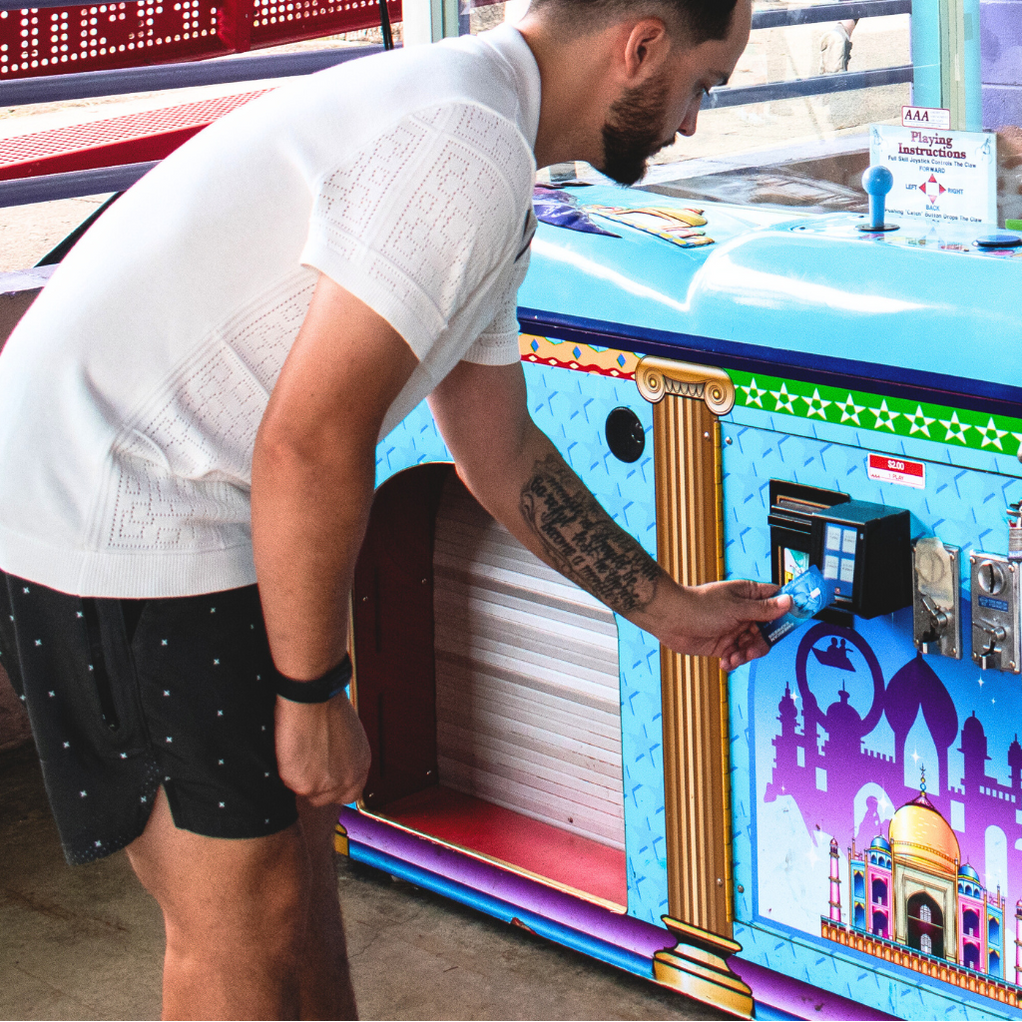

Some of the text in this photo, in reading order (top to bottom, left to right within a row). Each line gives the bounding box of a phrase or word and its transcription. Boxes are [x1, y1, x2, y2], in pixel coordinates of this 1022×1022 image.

[904, 109, 929, 122] AAA
[911, 131, 953, 149] Playing
[898, 143, 967, 159] Instructions
[910, 157, 930, 165] Joystick
[919, 166, 945, 174] FORWARD
[947, 187, 964, 195] RIGHT
[887, 459, 905, 471] $2.00
